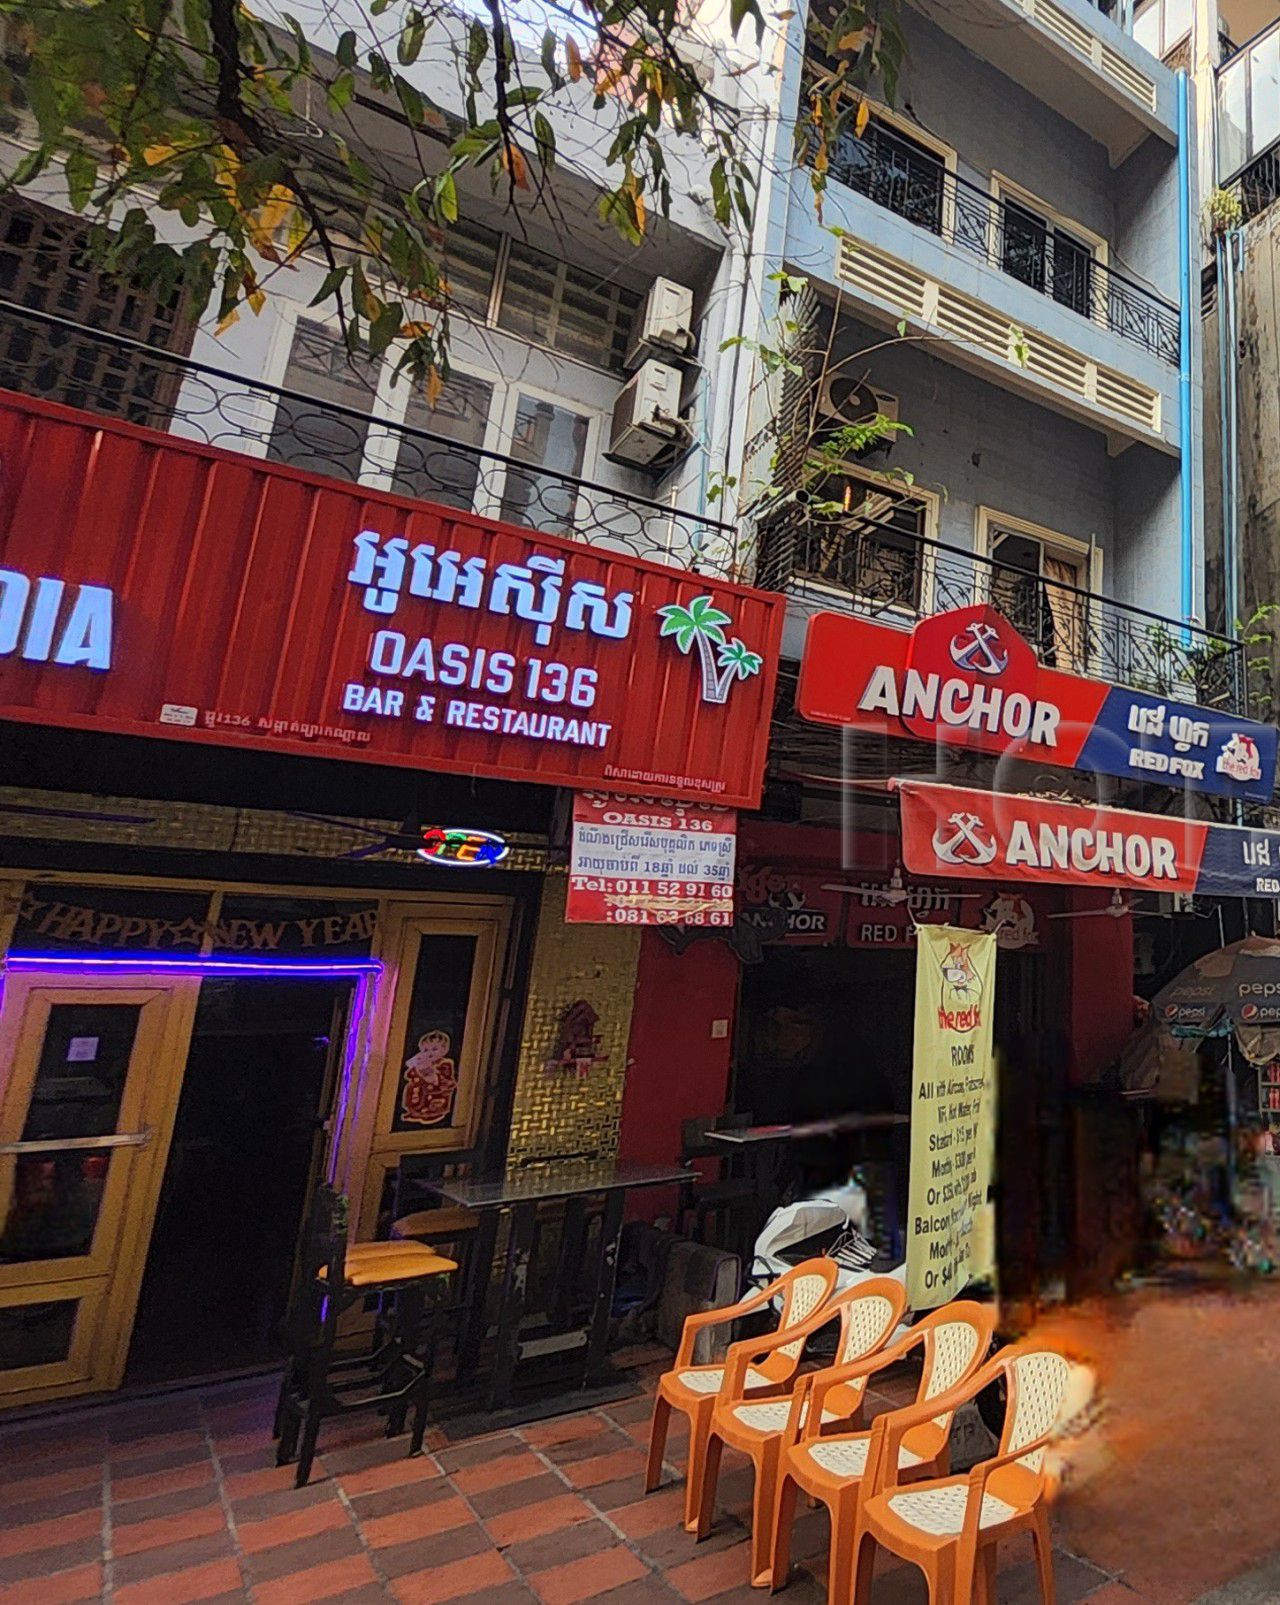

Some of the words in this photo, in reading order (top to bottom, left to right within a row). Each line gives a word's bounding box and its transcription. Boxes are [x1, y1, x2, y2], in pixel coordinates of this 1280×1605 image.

[370, 629, 516, 694] OASIS
[526, 658, 599, 708] 136
[342, 683, 404, 717] BAR
[415, 694, 436, 722] &
[446, 700, 612, 748] RESTAURANT
[856, 665, 1061, 747] ANCHOR
[1129, 748, 1169, 772] RED
[1169, 756, 1205, 780] FOX
[602, 810, 672, 829] OASIS
[678, 819, 713, 832] 136
[1006, 820, 1178, 879] ANCHOR
[658, 882, 681, 896] 52
[686, 883, 707, 897] 91
[711, 885, 734, 899] 60
[1256, 878, 1280, 893] RED
[33, 899, 172, 948] HAPPY
[710, 912, 732, 926] 61
[861, 923, 897, 942] RED
[919, 1082, 934, 1099] All
[927, 1187, 941, 1206] Or
[924, 1269, 939, 1290] Or
